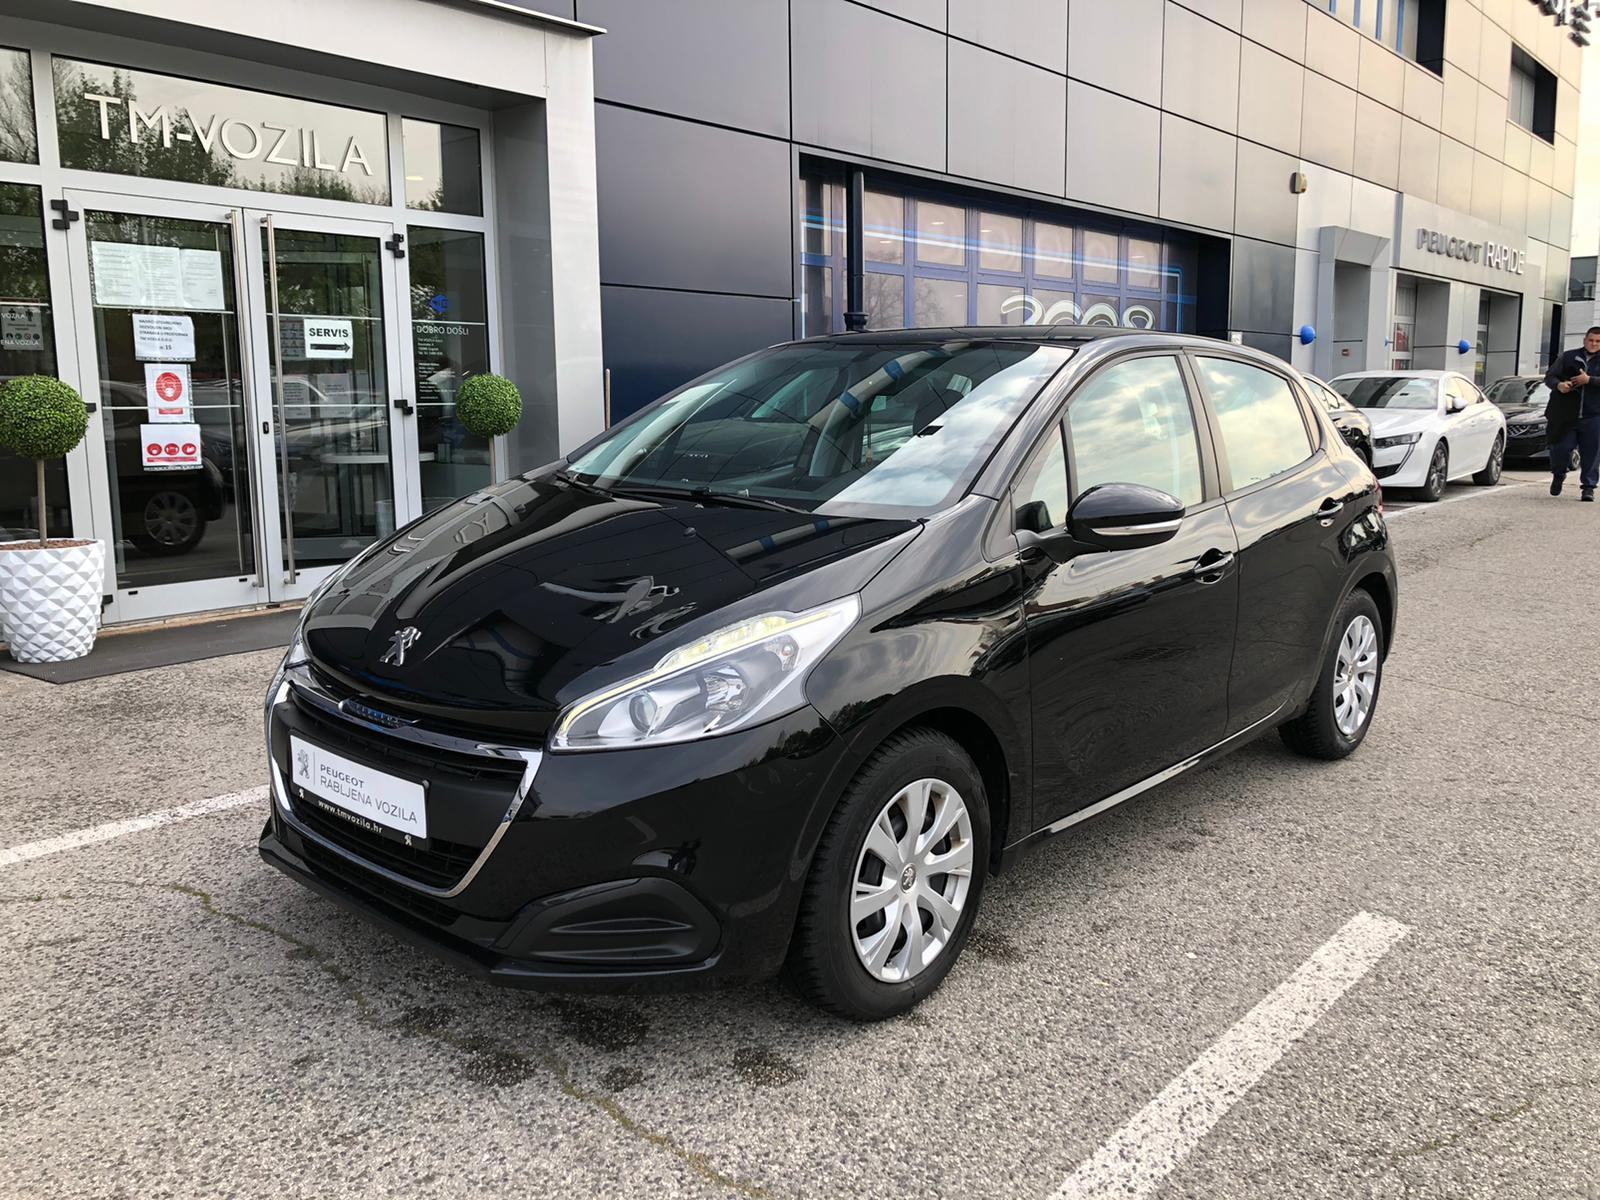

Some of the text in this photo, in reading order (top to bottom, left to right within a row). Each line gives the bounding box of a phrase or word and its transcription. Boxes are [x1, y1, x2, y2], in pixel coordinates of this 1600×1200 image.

[84, 93, 373, 176] TM-VOZILA
[1416, 228, 1525, 275] PEUGEOT RAPIDE
[309, 327, 349, 338] SERVIS
[416, 325, 469, 336] DOBRO DOŠLI
[320, 764, 364, 788] PEUGEOT
[320, 775, 418, 824] RABLJENA VOZILA
